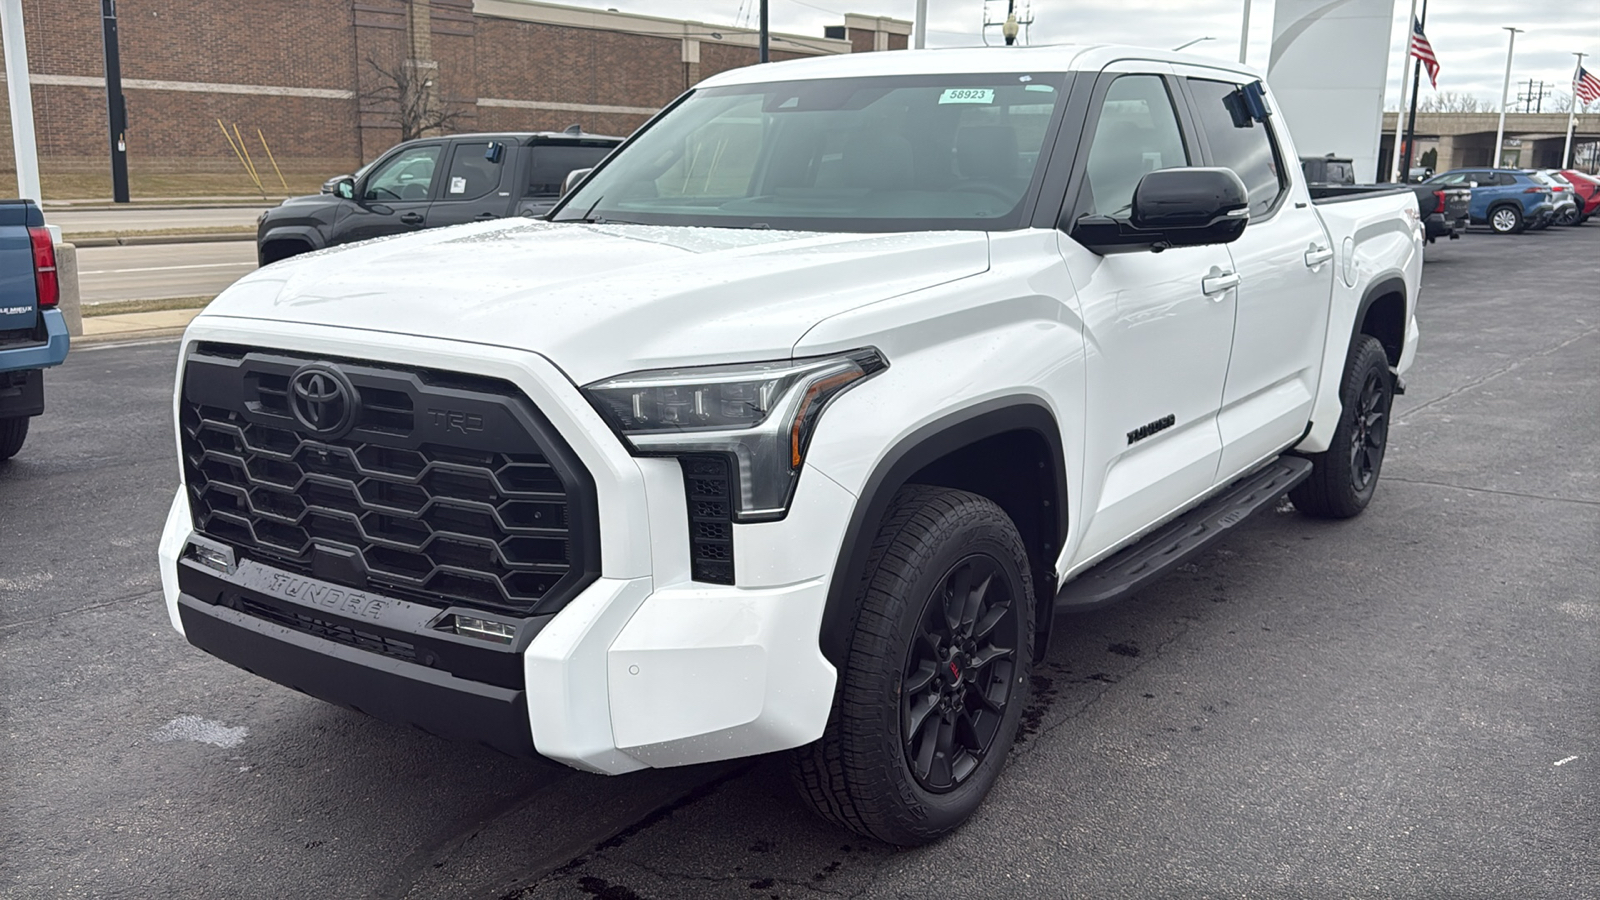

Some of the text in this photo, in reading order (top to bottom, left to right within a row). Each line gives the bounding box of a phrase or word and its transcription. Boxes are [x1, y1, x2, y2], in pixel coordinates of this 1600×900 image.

[949, 90, 986, 99] 58923
[10, 305, 33, 313] MIEUX
[428, 408, 484, 434] TRD
[1126, 413, 1176, 446] TUNDRA
[270, 573, 387, 620] TUNDRA
